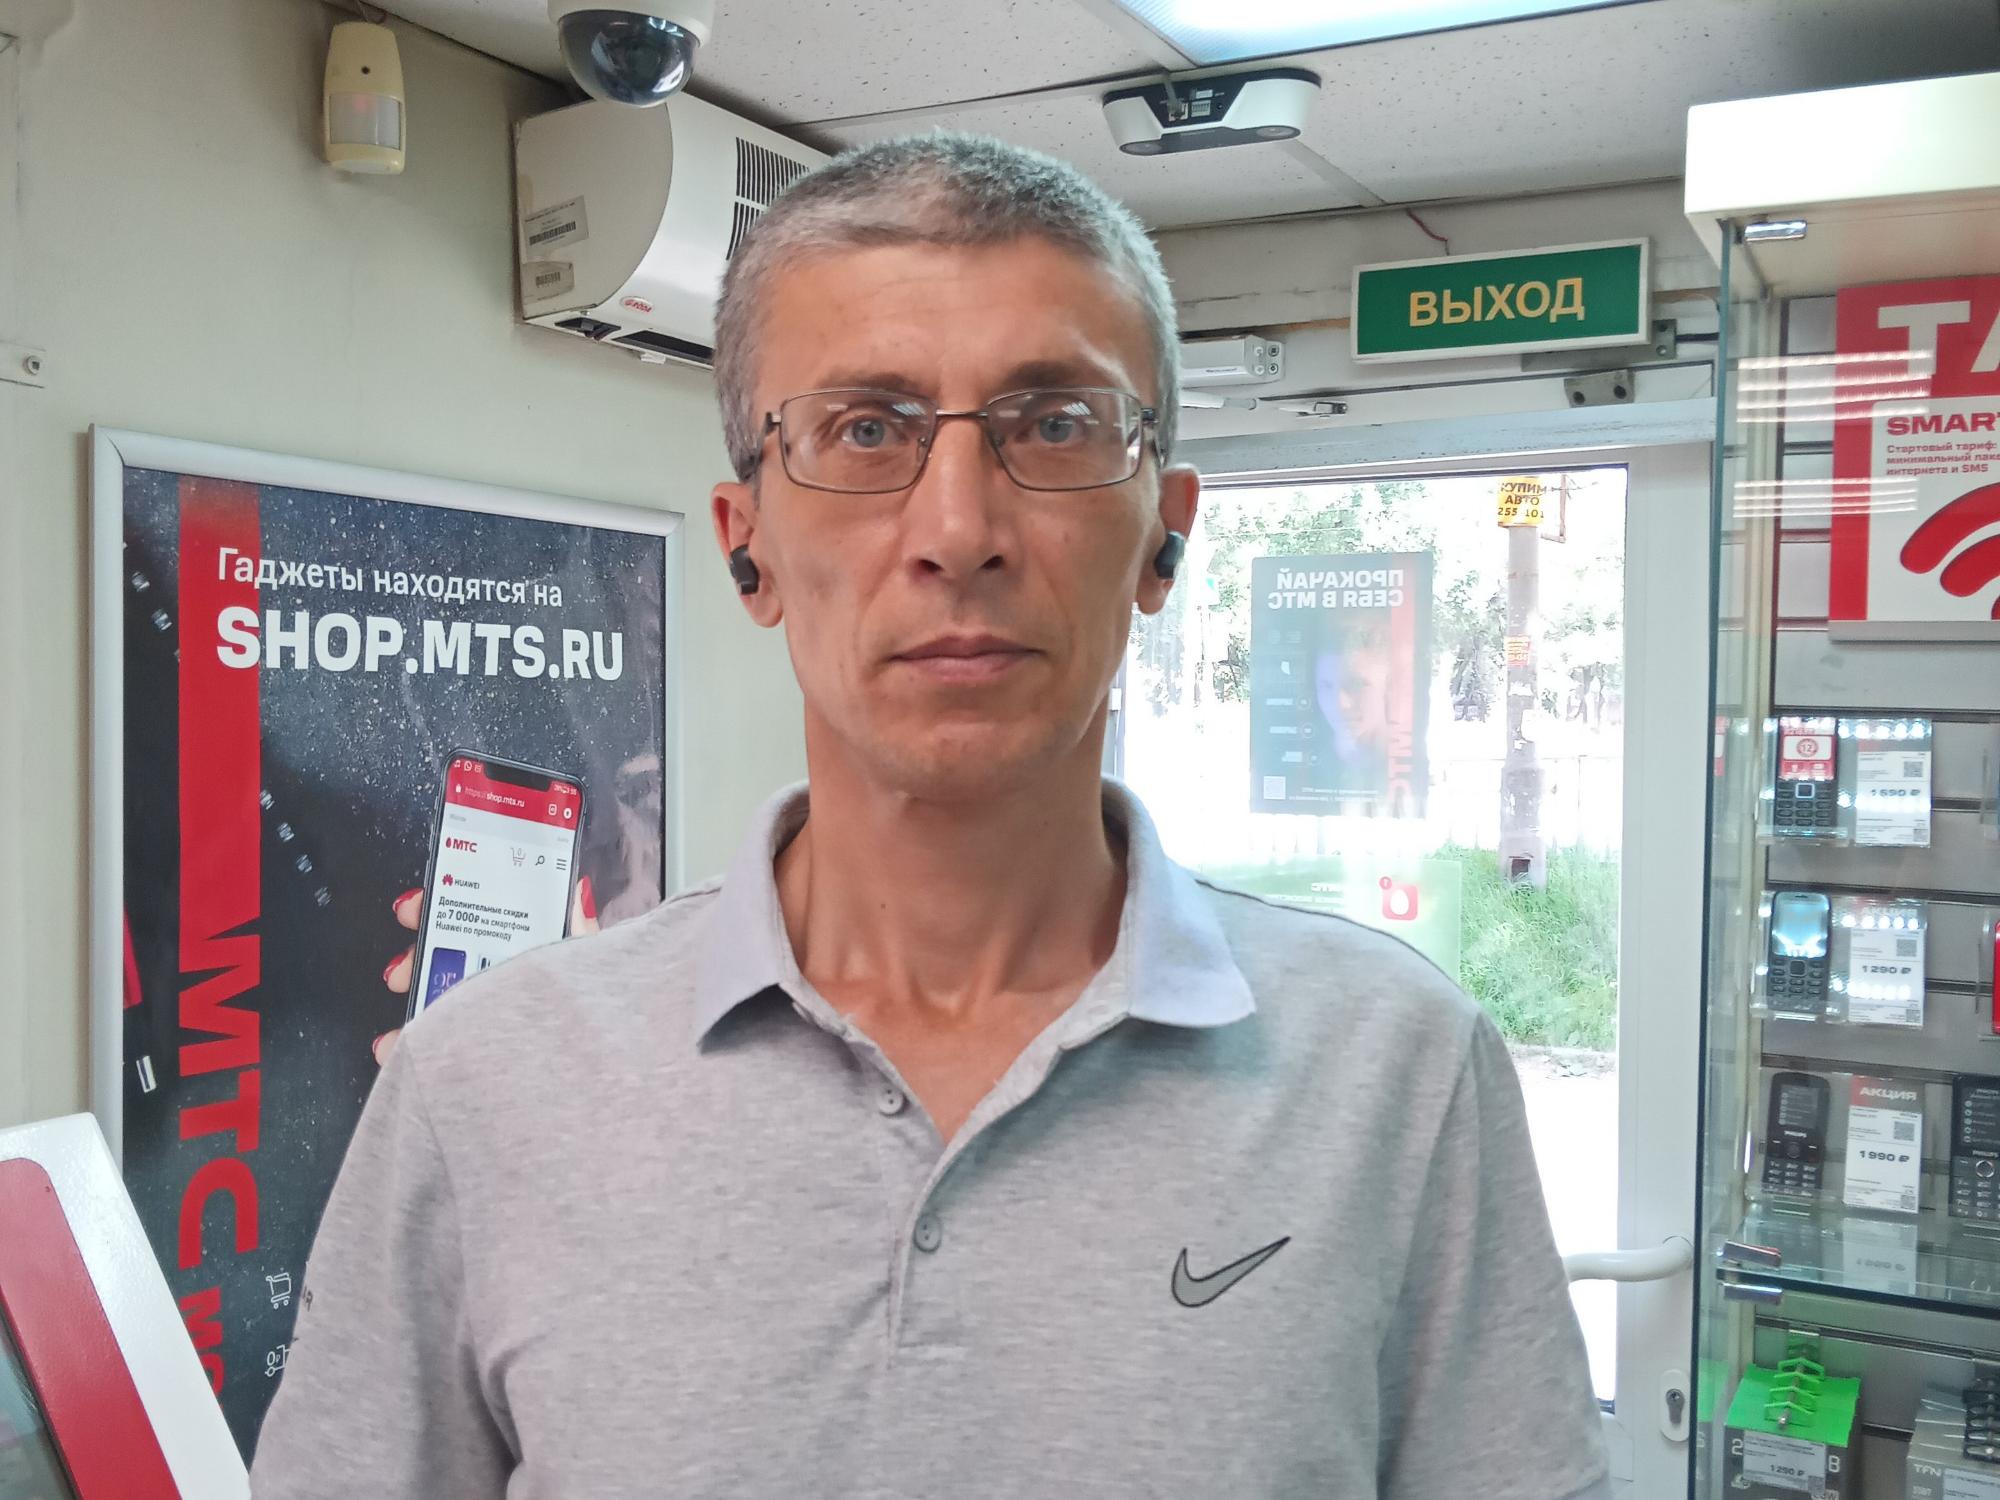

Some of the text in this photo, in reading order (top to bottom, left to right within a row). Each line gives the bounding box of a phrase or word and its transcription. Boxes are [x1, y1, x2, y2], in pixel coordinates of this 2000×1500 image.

[1409, 277, 1585, 327] ВЫХОД
[1887, 441, 1997, 454] Стартовый тариф:
[1887, 453, 1971, 464] минимальный
[1887, 466, 1948, 476] интернета
[1962, 463, 1989, 473] SMS
[1504, 494, 1539, 506] АВТО
[218, 547, 563, 608] Гаджеты находятся на
[216, 605, 624, 682] SHOP.MTS.RU
[452, 838, 478, 853] МТС
[454, 879, 480, 889] HUAWEI
[439, 896, 529, 919] Дополнительные скидки
[436, 911, 447, 919] до
[491, 919, 530, 931] смартфоны
[435, 920, 512, 941] Huawei по промокоду
[1860, 1087, 1917, 1101] АКЦИЯ
[178, 934, 261, 1273] МТС
